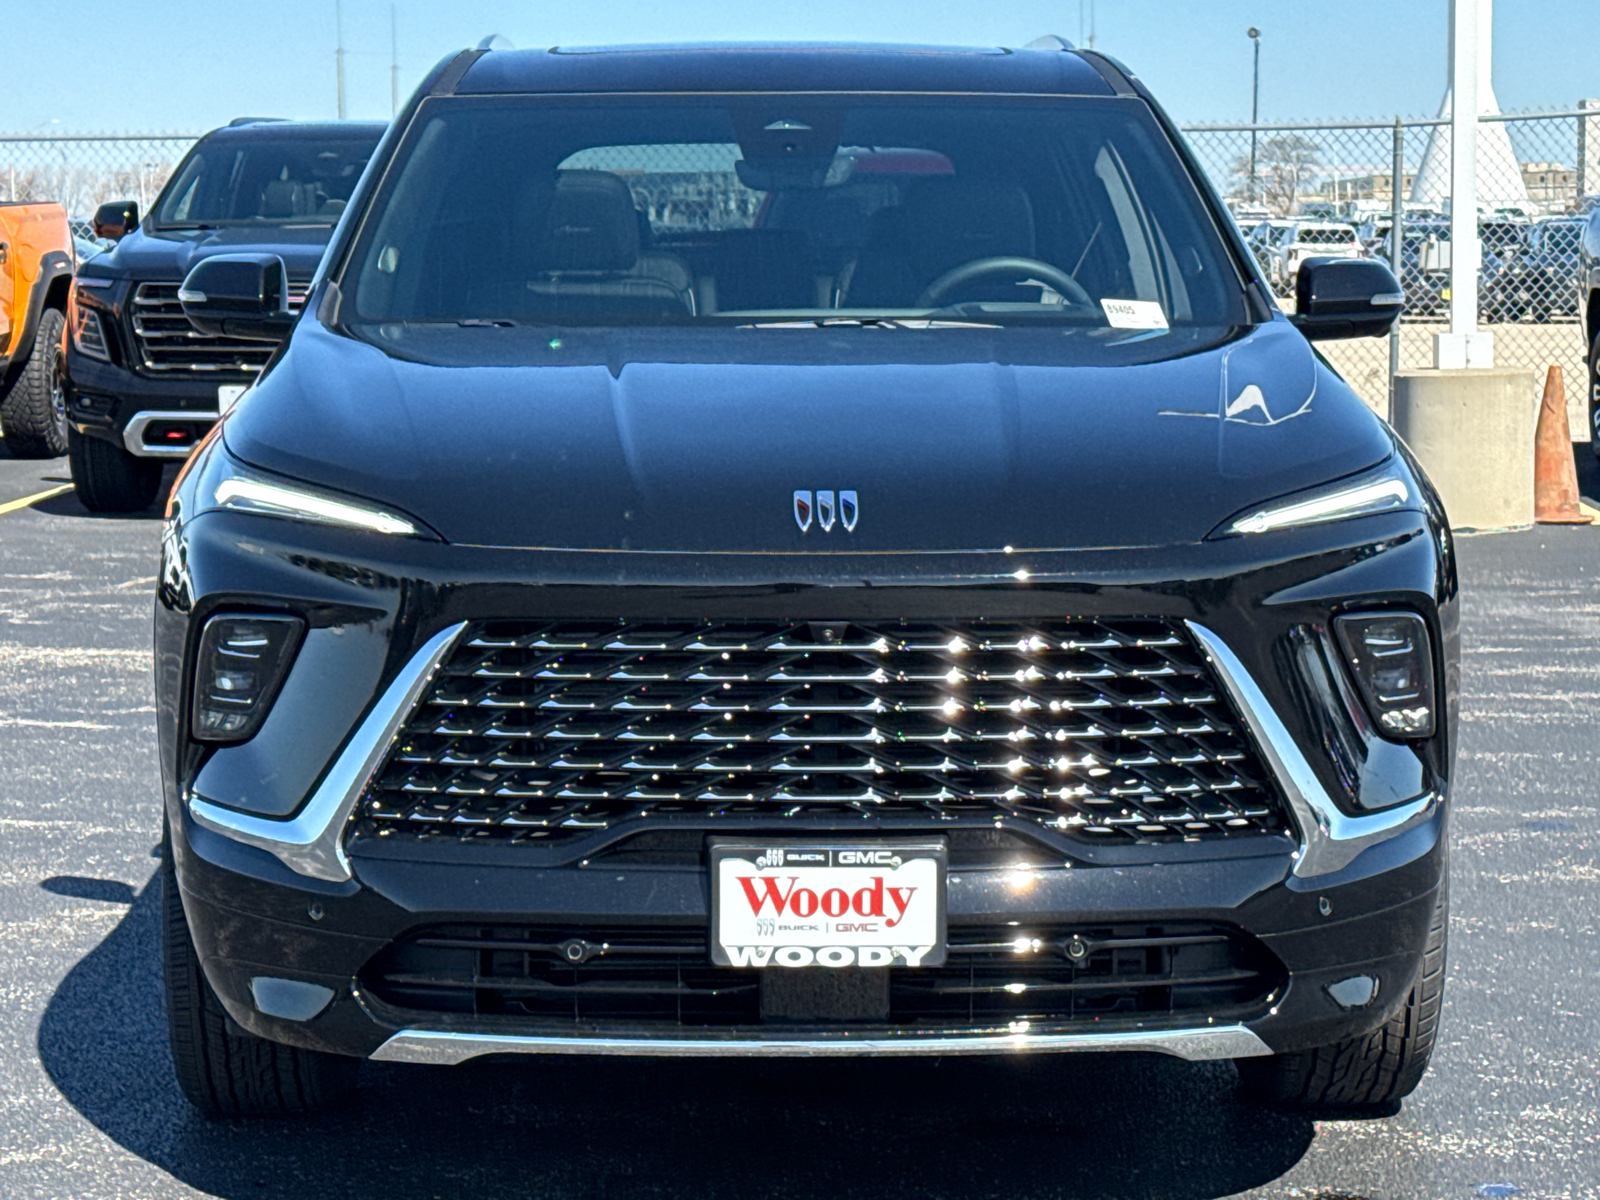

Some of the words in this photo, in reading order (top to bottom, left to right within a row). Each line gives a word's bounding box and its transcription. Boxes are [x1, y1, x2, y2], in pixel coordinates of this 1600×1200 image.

[838, 851, 893, 864] GMC
[735, 876, 918, 928] Woody
[835, 923, 879, 932] GMC
[725, 946, 932, 968] WOODY
